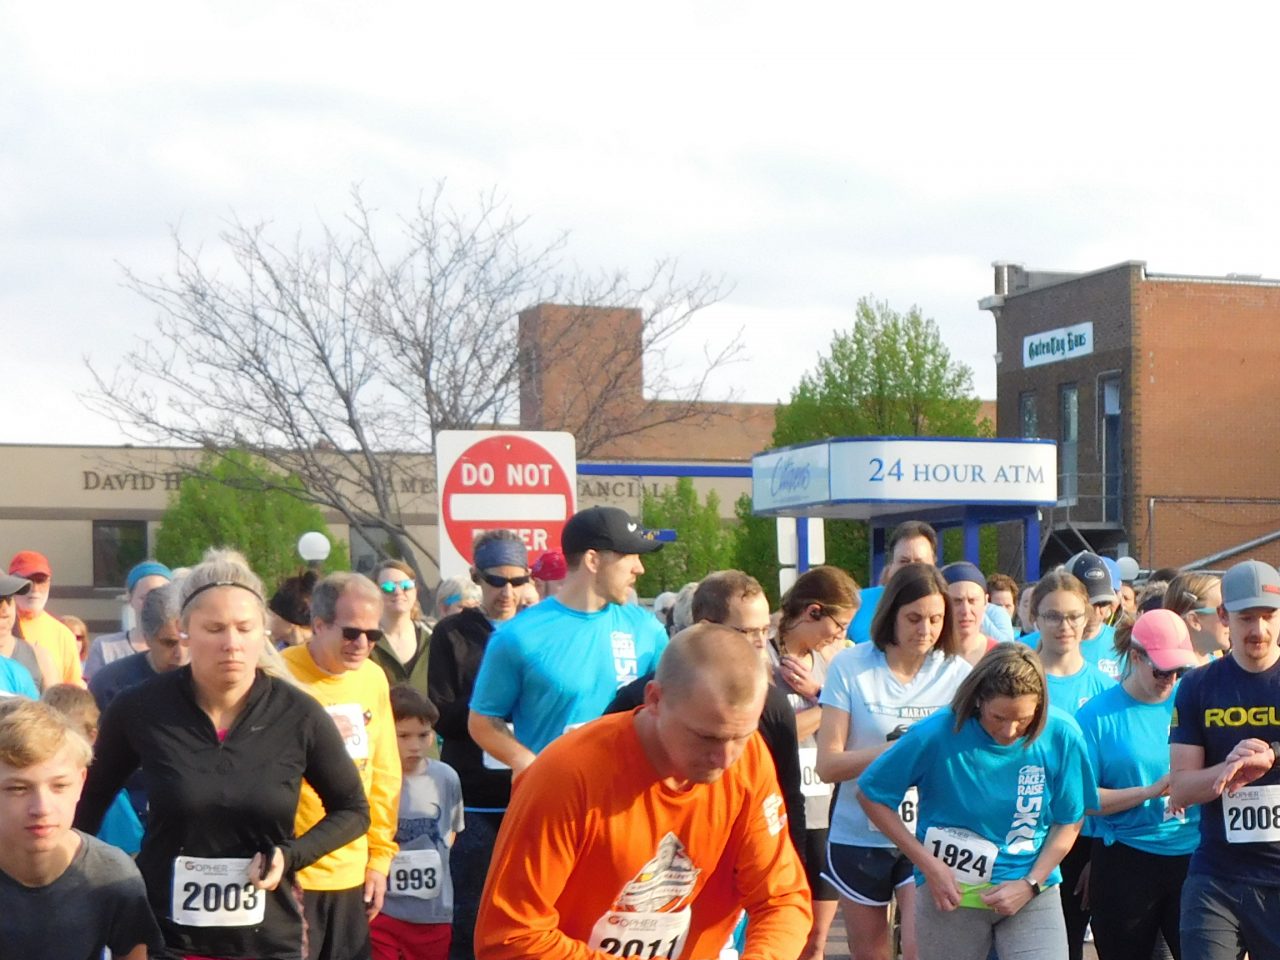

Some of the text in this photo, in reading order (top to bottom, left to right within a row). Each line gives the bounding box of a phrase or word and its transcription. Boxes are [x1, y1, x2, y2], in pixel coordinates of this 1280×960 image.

[461, 463, 495, 486] DO
[507, 463, 552, 486] NOT
[868, 457, 1045, 484] 24 HOUR ATM
[1017, 784, 1045, 796] RAISE
[1011, 796, 1043, 829] 5K
[185, 861, 228, 872] GOPHER
[932, 840, 988, 878] 1924
[182, 881, 258, 912] 2003
[608, 915, 658, 928] GOPHER
